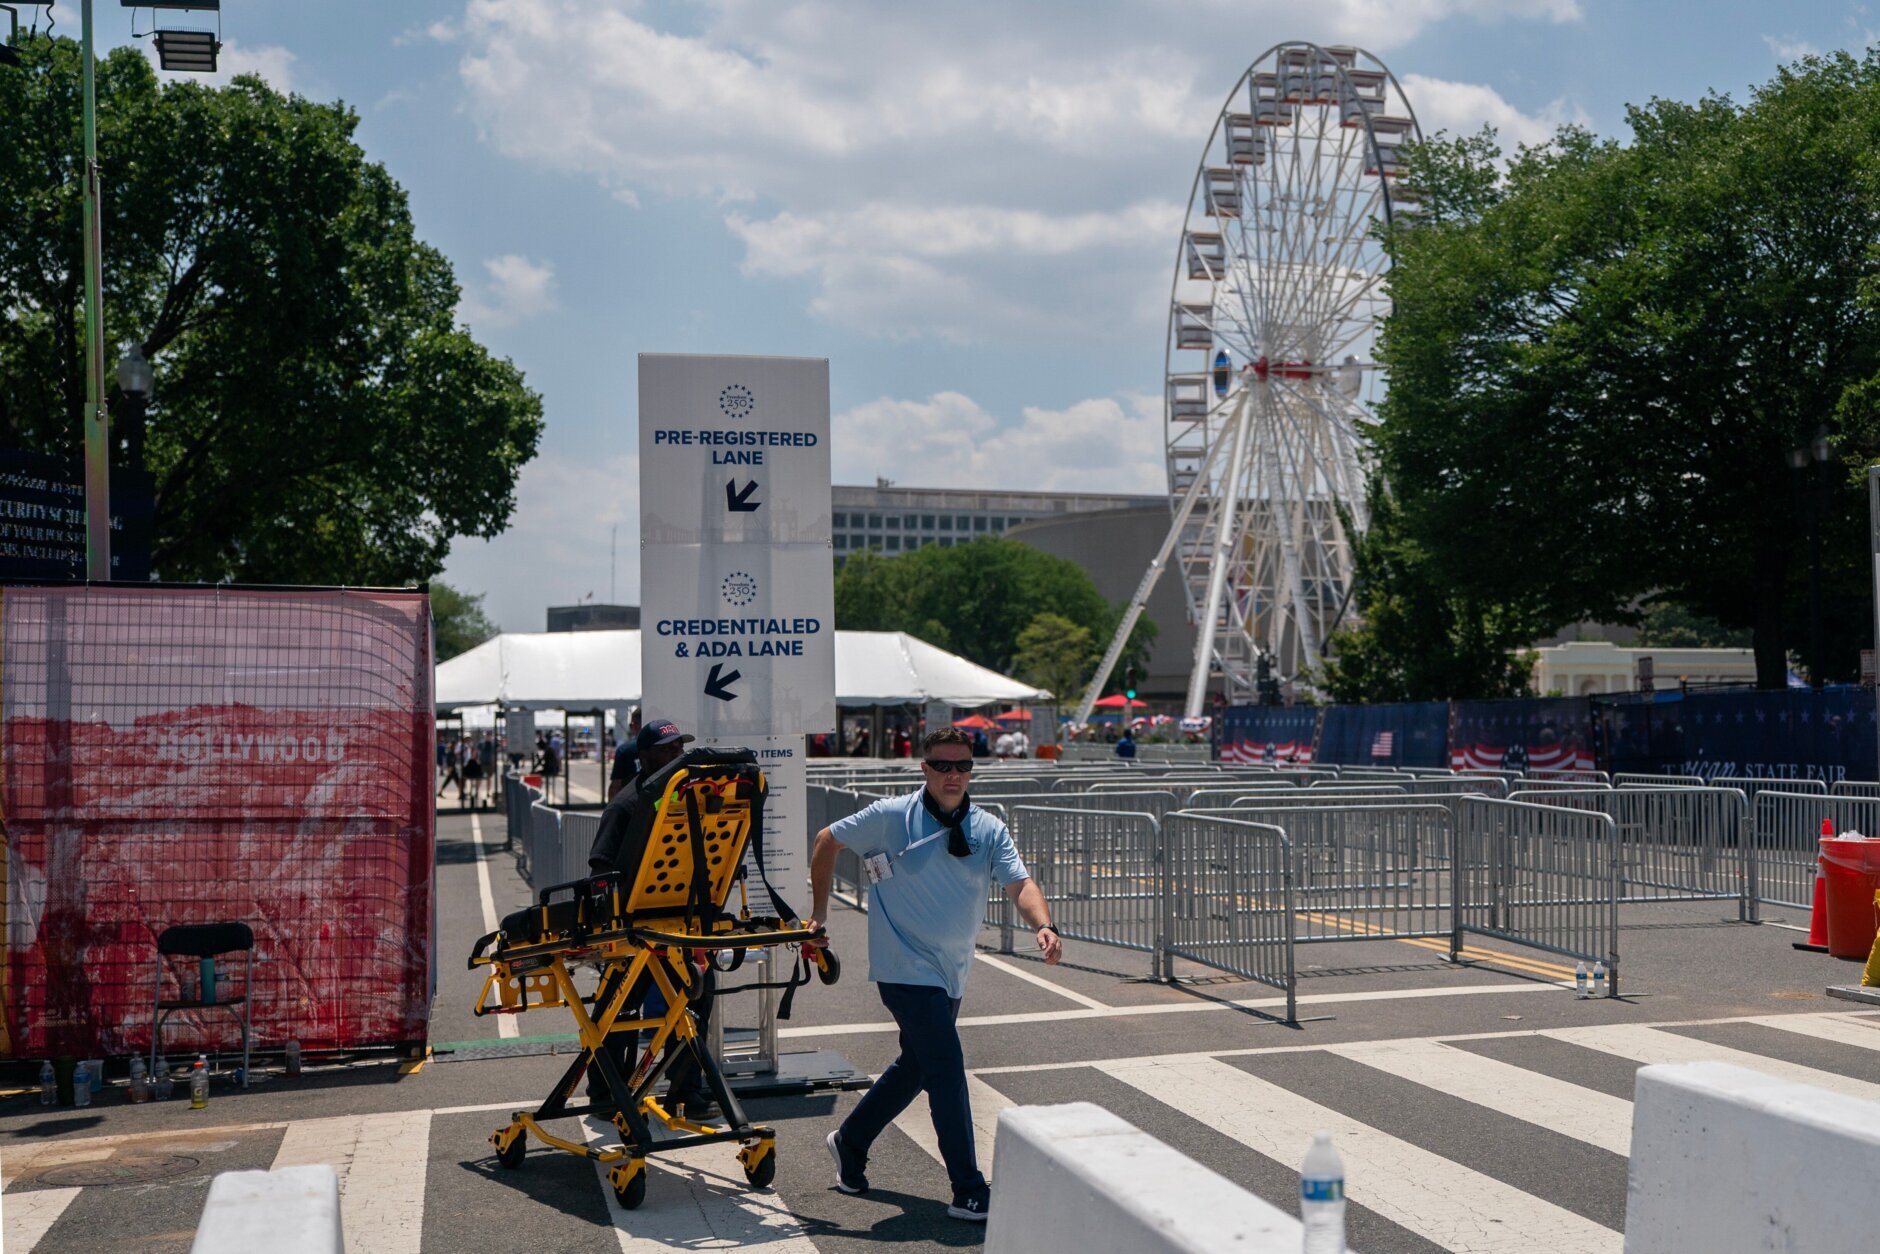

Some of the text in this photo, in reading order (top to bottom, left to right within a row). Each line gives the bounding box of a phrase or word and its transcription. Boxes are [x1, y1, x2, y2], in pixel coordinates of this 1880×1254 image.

[726, 399, 748, 410] 250
[654, 430, 818, 447] PRE-REGISTERED
[712, 450, 764, 465] LANE
[729, 586, 750, 598] 250
[656, 618, 820, 636] CREDENTIALED
[675, 640, 804, 658] & ADA LANE
[159, 730, 345, 762] HOLLYWOOD
[761, 749, 793, 758] ITEMS
[1745, 763, 1798, 778] STATE
[1806, 764, 1847, 782] FAIR
